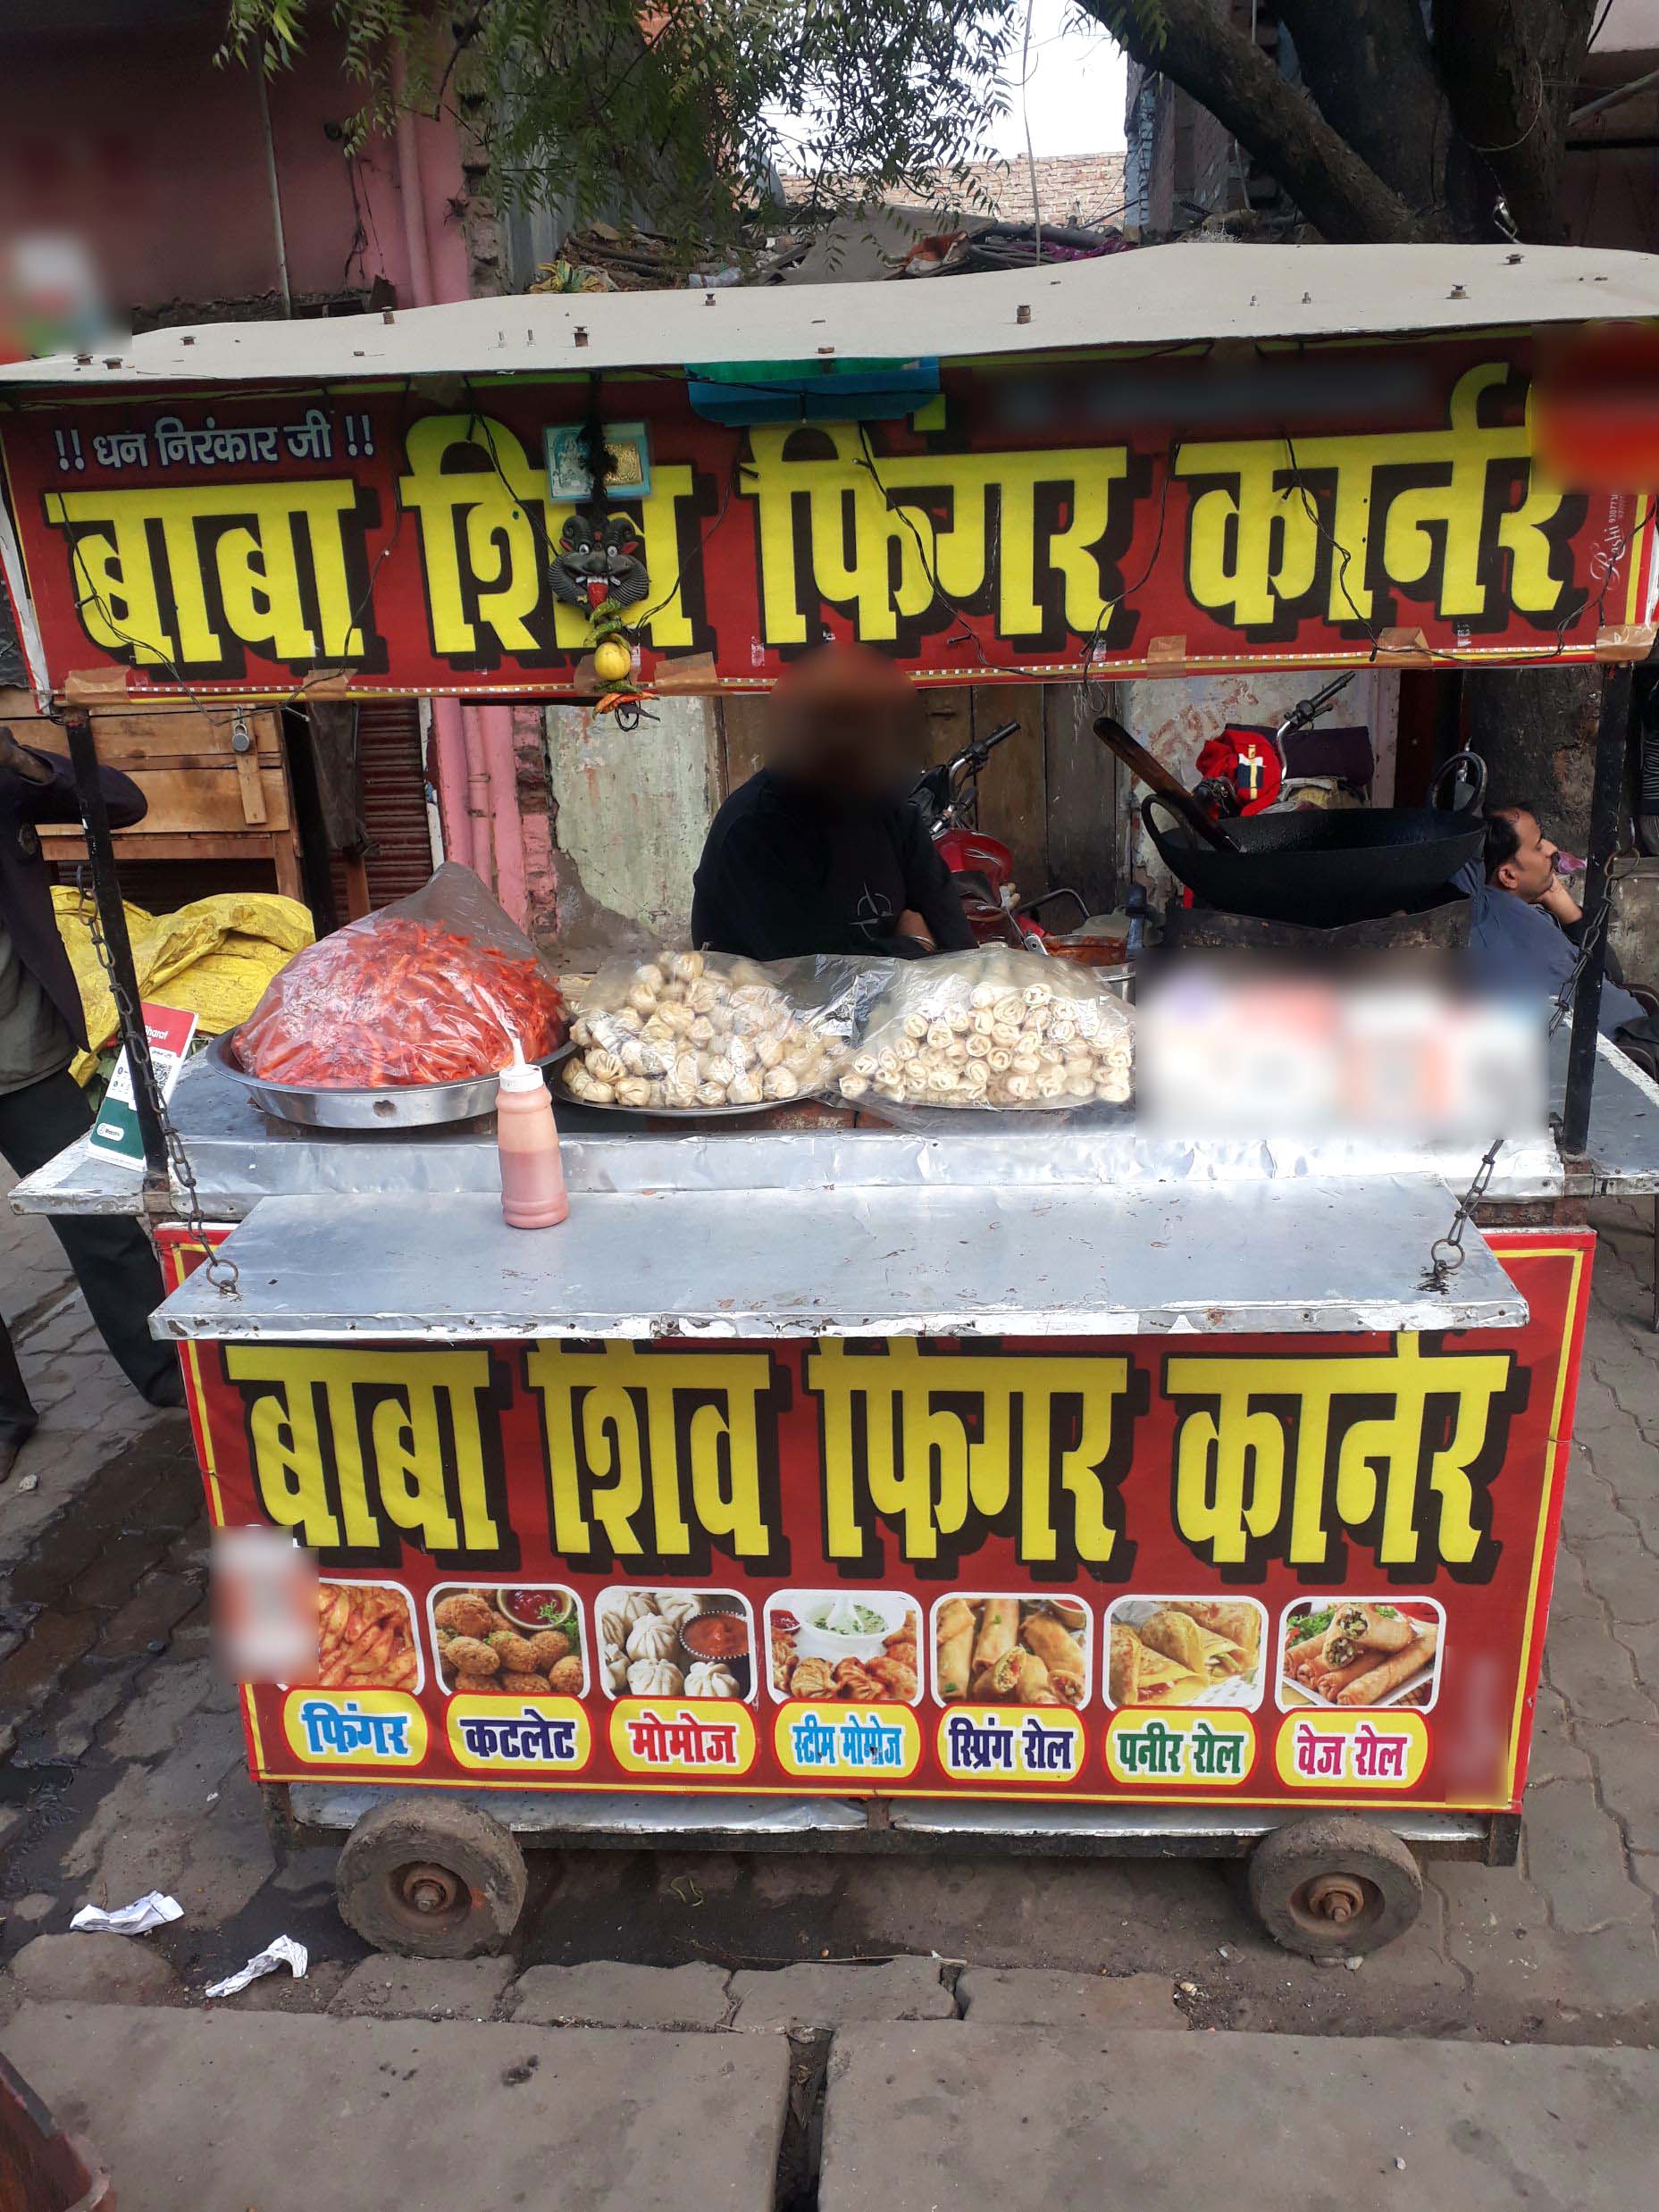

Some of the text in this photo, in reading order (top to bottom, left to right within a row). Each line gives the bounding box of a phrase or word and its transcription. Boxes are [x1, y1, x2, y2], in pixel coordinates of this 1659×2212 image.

[92, 432, 149, 468] धन
[155, 415, 279, 466] निरंकार
[283, 408, 331, 458] जी
[45, 479, 364, 665] बाबा
[225, 1345, 499, 1551] बाबा
[301, 1702, 408, 1755] फिंगर
[460, 1709, 576, 1759] कटलेट
[628, 1713, 736, 1763] मोमोज
[792, 1714, 901, 1766] स्टीम मोमोज
[1022, 1718, 1074, 1769] रोल
[1118, 1722, 1244, 1773] पनीर रोल
[1297, 1724, 1408, 1776] वेज रोल
